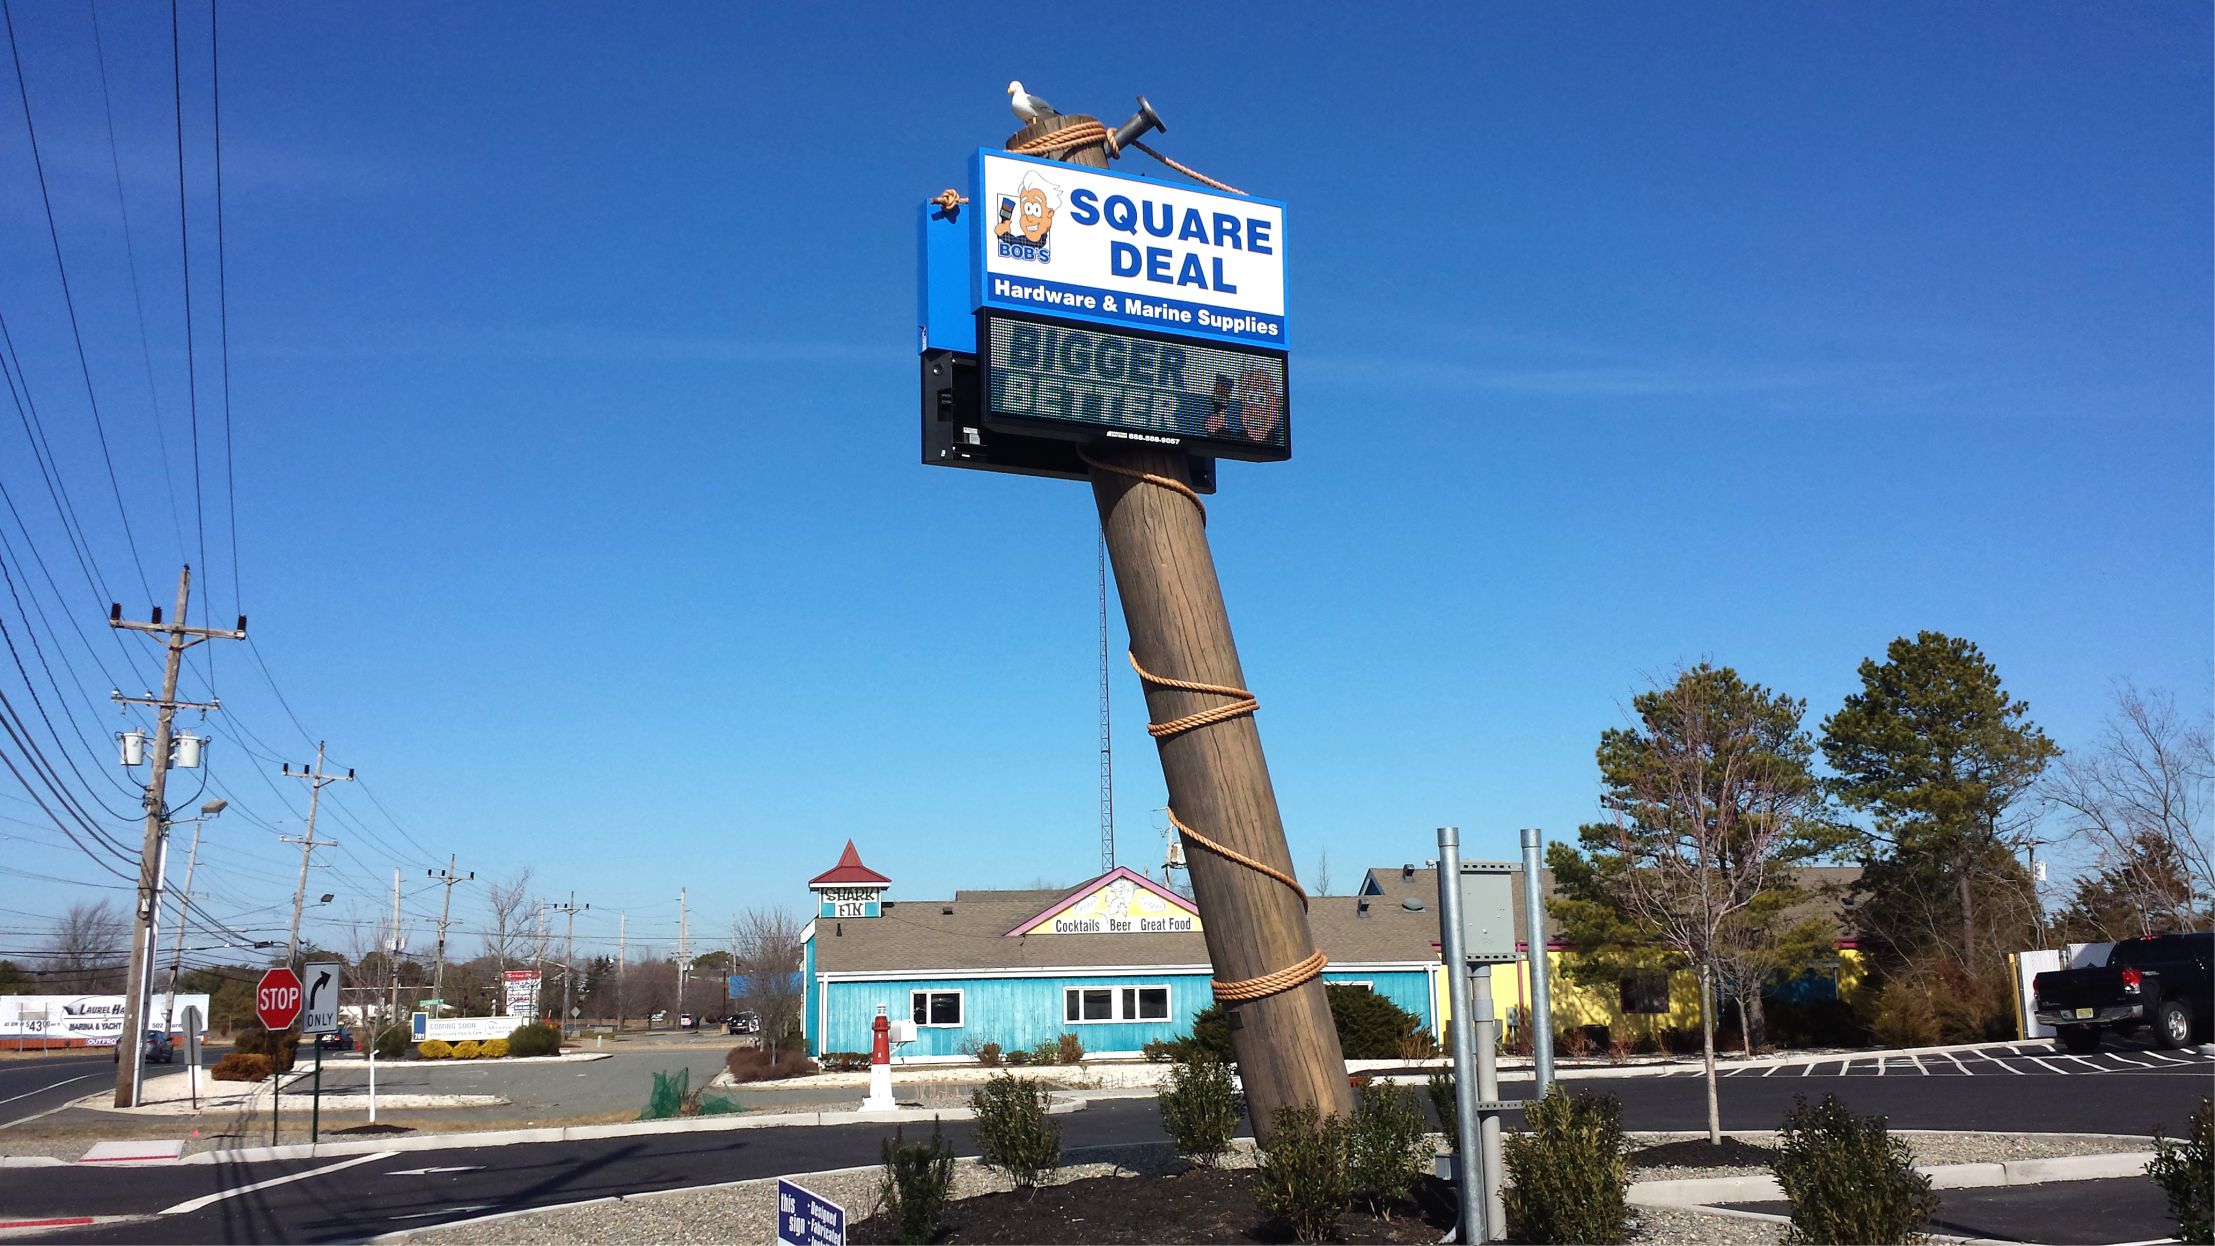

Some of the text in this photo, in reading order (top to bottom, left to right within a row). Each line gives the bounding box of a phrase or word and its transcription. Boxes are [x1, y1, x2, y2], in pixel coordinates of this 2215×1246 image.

[1070, 189, 1273, 256] SQUARE
[998, 242, 1051, 264] BOB'S
[1110, 240, 1238, 295] DEAL
[994, 279, 1279, 336] Hardware & Marine Supplies
[1008, 324, 1186, 389] BIGGER
[1003, 372, 1180, 429] BETTER
[824, 886, 876, 902] SHARK
[838, 902, 864, 917] FIN
[1055, 916, 1191, 933] Cocktails Beer Great Food
[80, 1003, 111, 1016] LAUREL
[260, 986, 299, 1011] STOP
[68, 1023, 96, 1032] MARINA
[101, 1022, 122, 1031] YACHT
[307, 1012, 334, 1029] ONLY
[429, 1022, 456, 1031] COMING
[458, 1022, 477, 1031] SOON
[781, 1193, 796, 1214] this
[810, 1200, 837, 1228] Designed
[789, 1214, 806, 1237] sign
